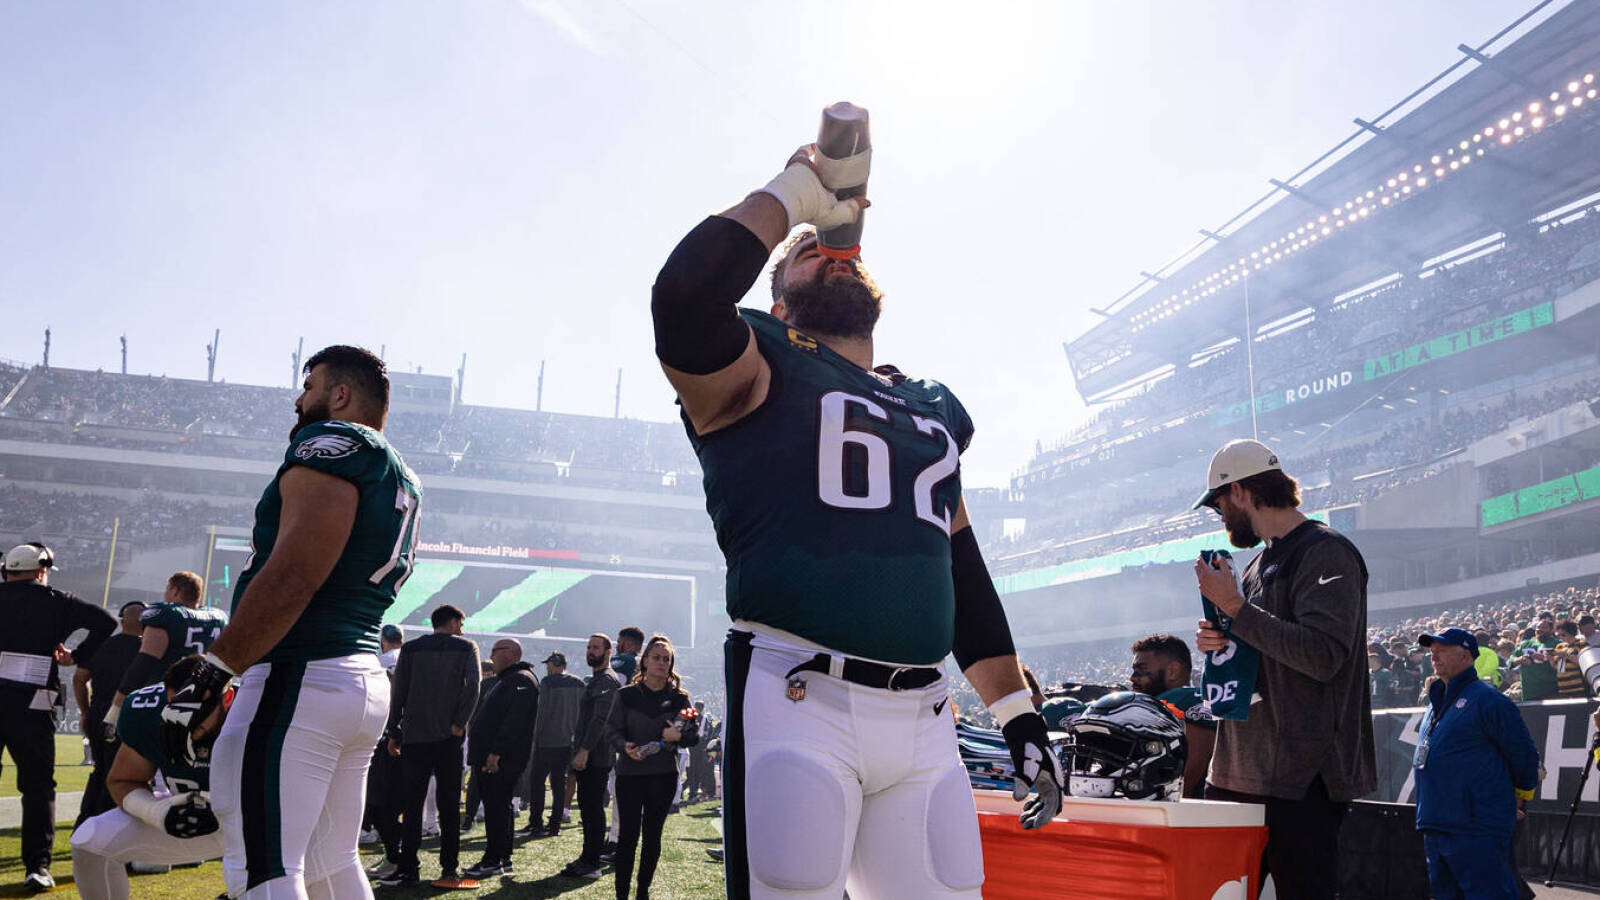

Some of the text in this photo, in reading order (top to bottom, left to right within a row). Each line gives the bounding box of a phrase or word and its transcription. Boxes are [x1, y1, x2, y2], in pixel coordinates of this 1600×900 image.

[788, 327, 818, 349] C
[1285, 371, 1353, 404] ROUND
[1373, 353, 1401, 377] AT
[1417, 347, 1431, 362] A
[1448, 317, 1514, 353] TIME
[818, 391, 959, 541] 62
[416, 541, 529, 559] incoln Financial Field
[131, 681, 165, 709] 63
